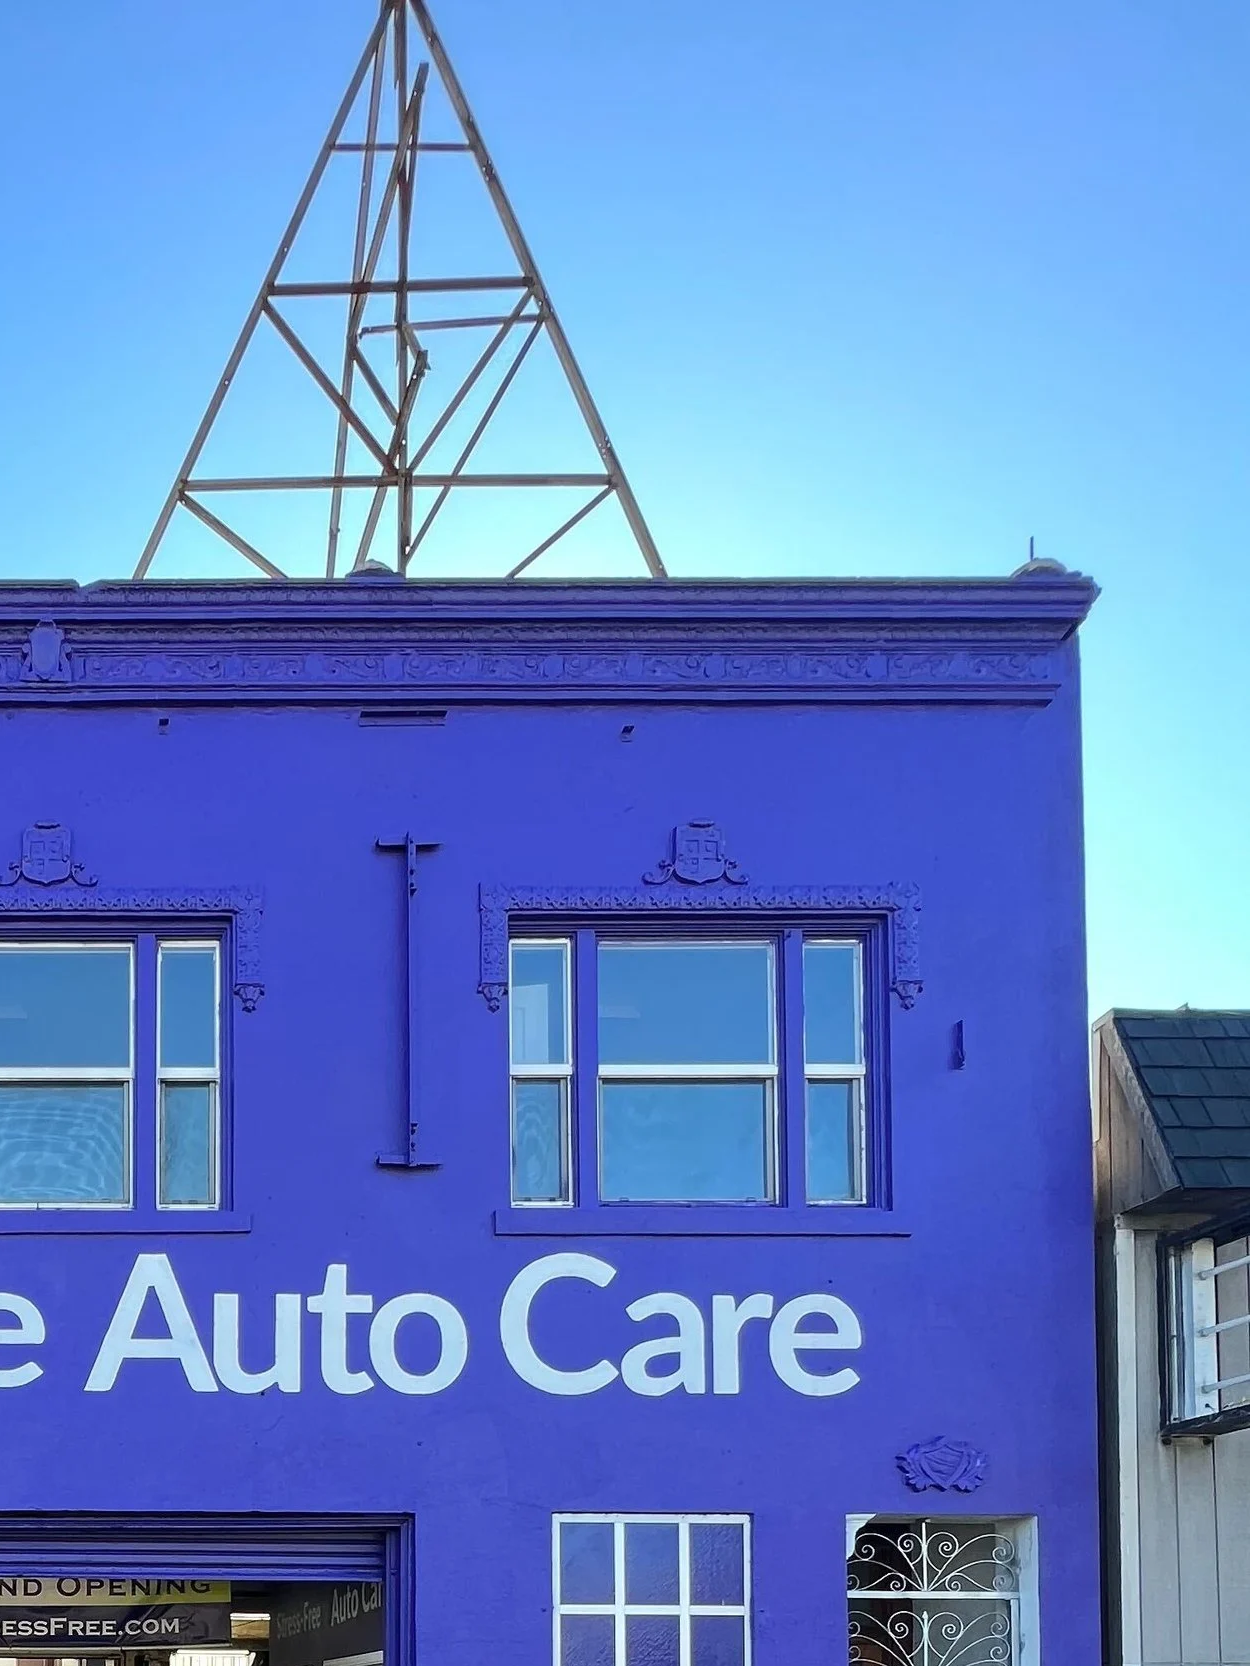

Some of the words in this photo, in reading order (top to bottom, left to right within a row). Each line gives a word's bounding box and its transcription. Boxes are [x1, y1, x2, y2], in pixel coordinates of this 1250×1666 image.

[83, 1253, 469, 1395] Auto
[499, 1252, 862, 1397] Care
[56, 1577, 212, 1596] OPENING
[276, 1601, 321, 1640] Stress-Free
[330, 1584, 359, 1627] Auto
